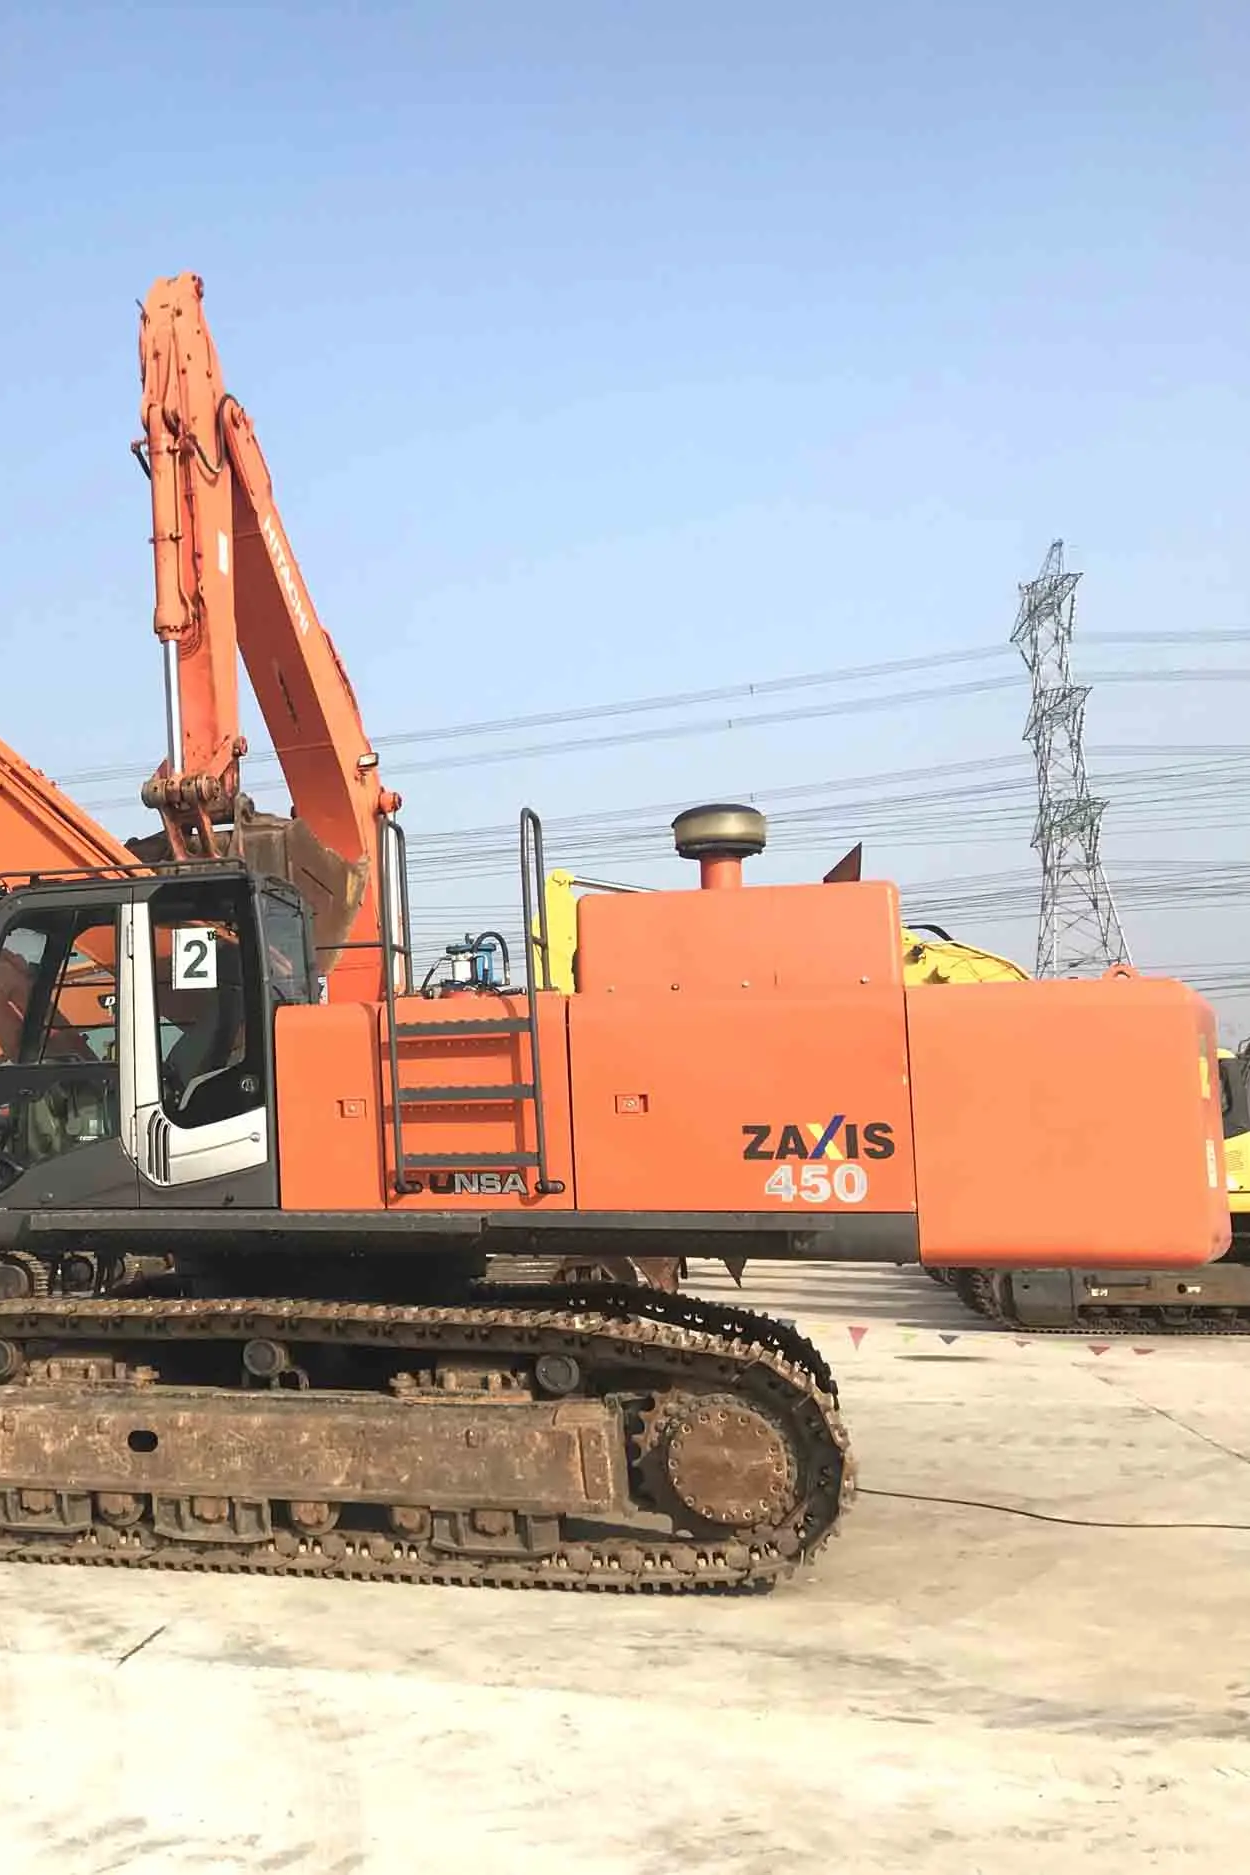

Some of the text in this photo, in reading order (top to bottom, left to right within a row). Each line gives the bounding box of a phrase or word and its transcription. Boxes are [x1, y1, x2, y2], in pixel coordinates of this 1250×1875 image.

[263, 514, 309, 636] HITACHI
[182, 939, 208, 979] 2
[741, 1114, 896, 1161] ZAXIS
[764, 1163, 869, 1203] 450
